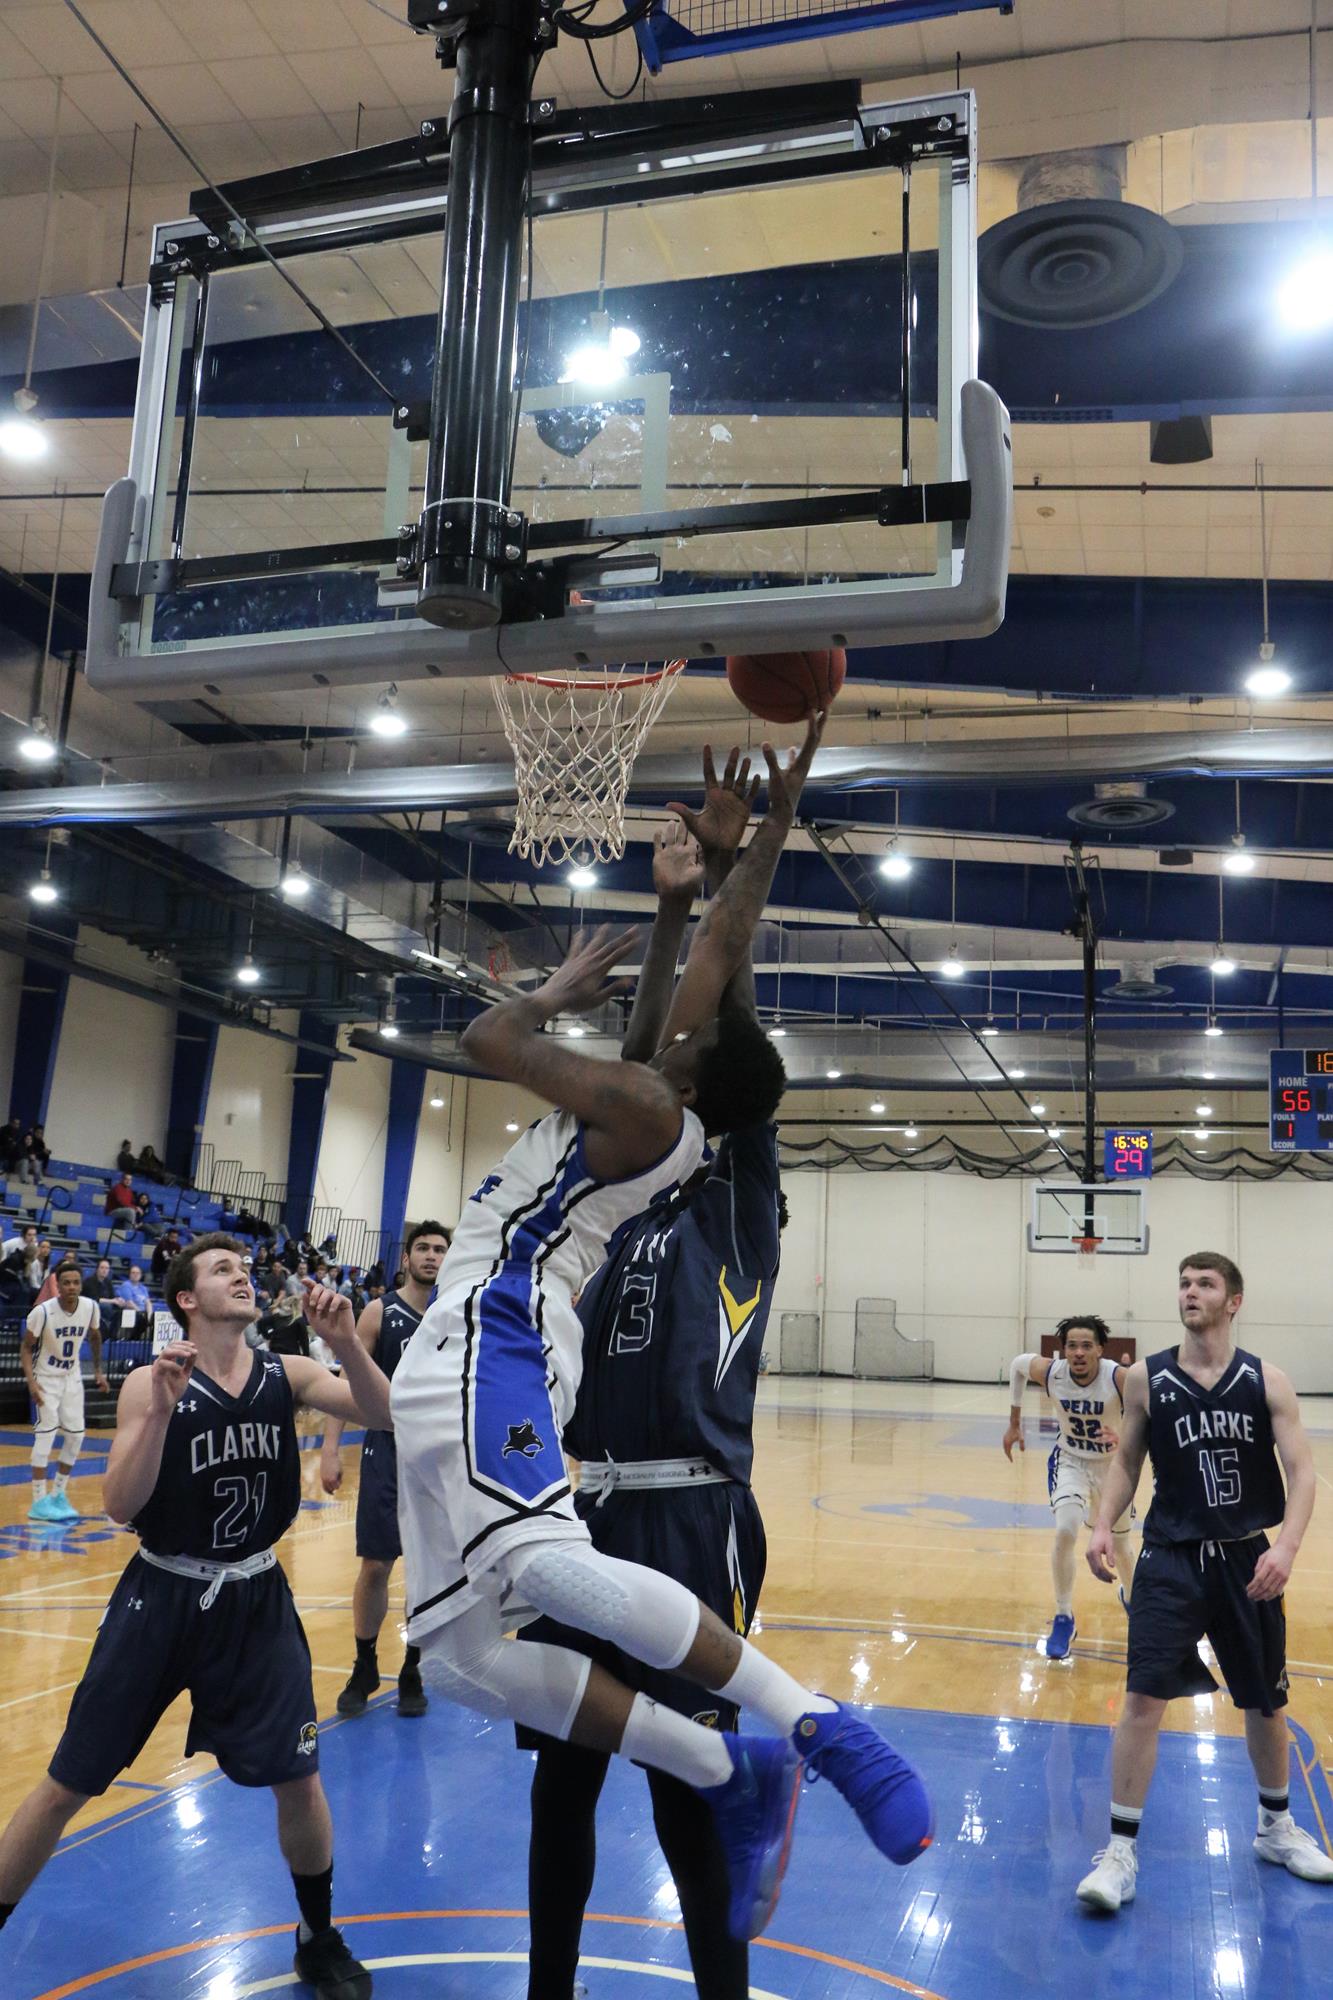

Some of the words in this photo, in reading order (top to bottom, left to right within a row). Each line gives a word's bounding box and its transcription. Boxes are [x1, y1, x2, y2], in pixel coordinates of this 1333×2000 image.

[1279, 1077, 1309, 1087] HOME
[1282, 1090, 1311, 1112] 56
[1273, 1113, 1296, 1121] FOULS
[1287, 1122, 1294, 1138] 1
[1113, 1135, 1149, 1150] 16:46
[1273, 1141, 1296, 1149] SCORE
[1115, 1149, 1143, 1173] 29
[55, 1326, 85, 1339] PERU
[63, 1340, 74, 1358] 0
[48, 1355, 75, 1371] STAT
[1060, 1399, 1105, 1416] PERU
[1069, 1416, 1104, 1440] 32
[1174, 1410, 1255, 1449] CLARKE
[1199, 1448, 1242, 1508] 15
[211, 1471, 268, 1549] 21
